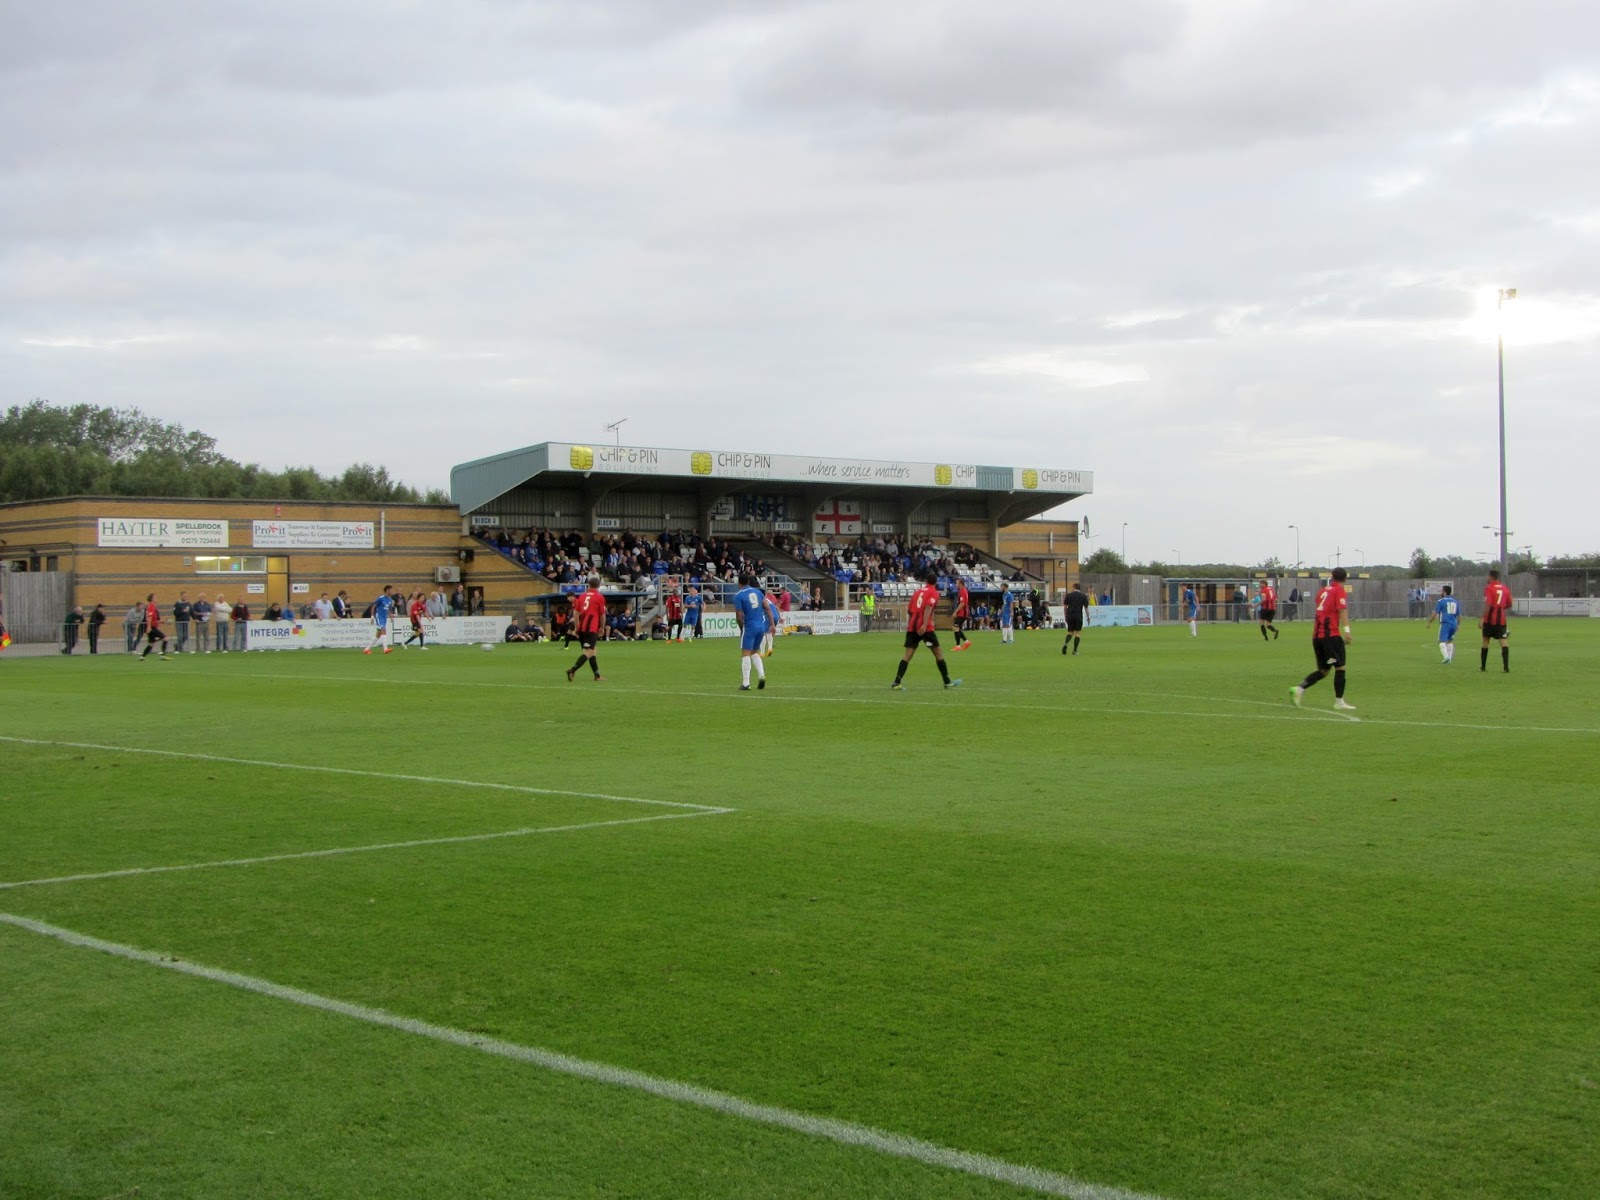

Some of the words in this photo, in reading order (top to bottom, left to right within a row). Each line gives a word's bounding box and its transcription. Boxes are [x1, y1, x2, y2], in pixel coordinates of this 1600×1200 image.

[600, 448, 624, 462] CHIP
[628, 449, 638, 462] &
[640, 450, 658, 464] PIN
[718, 454, 742, 467] CHIP
[744, 455, 753, 467] &
[755, 456, 771, 468] PIN
[600, 464, 658, 472] SOLUTIONS
[717, 470, 771, 478] SOLUTIONS
[841, 464, 871, 477] service
[875, 464, 910, 478] matters
[955, 466, 974, 478] CHIP
[1041, 470, 1059, 482] CHIP
[1060, 472, 1067, 482] &
[1068, 472, 1081, 483] PIN
[102, 522, 168, 535] HAYTER
[583, 596, 591, 610] 5
[748, 593, 758, 608] 9
[917, 592, 924, 608] 6
[1317, 591, 1328, 610] 2
[1496, 590, 1503, 604] 7
[1447, 602, 1457, 614] 10
[251, 628, 290, 637] INTEGRA
